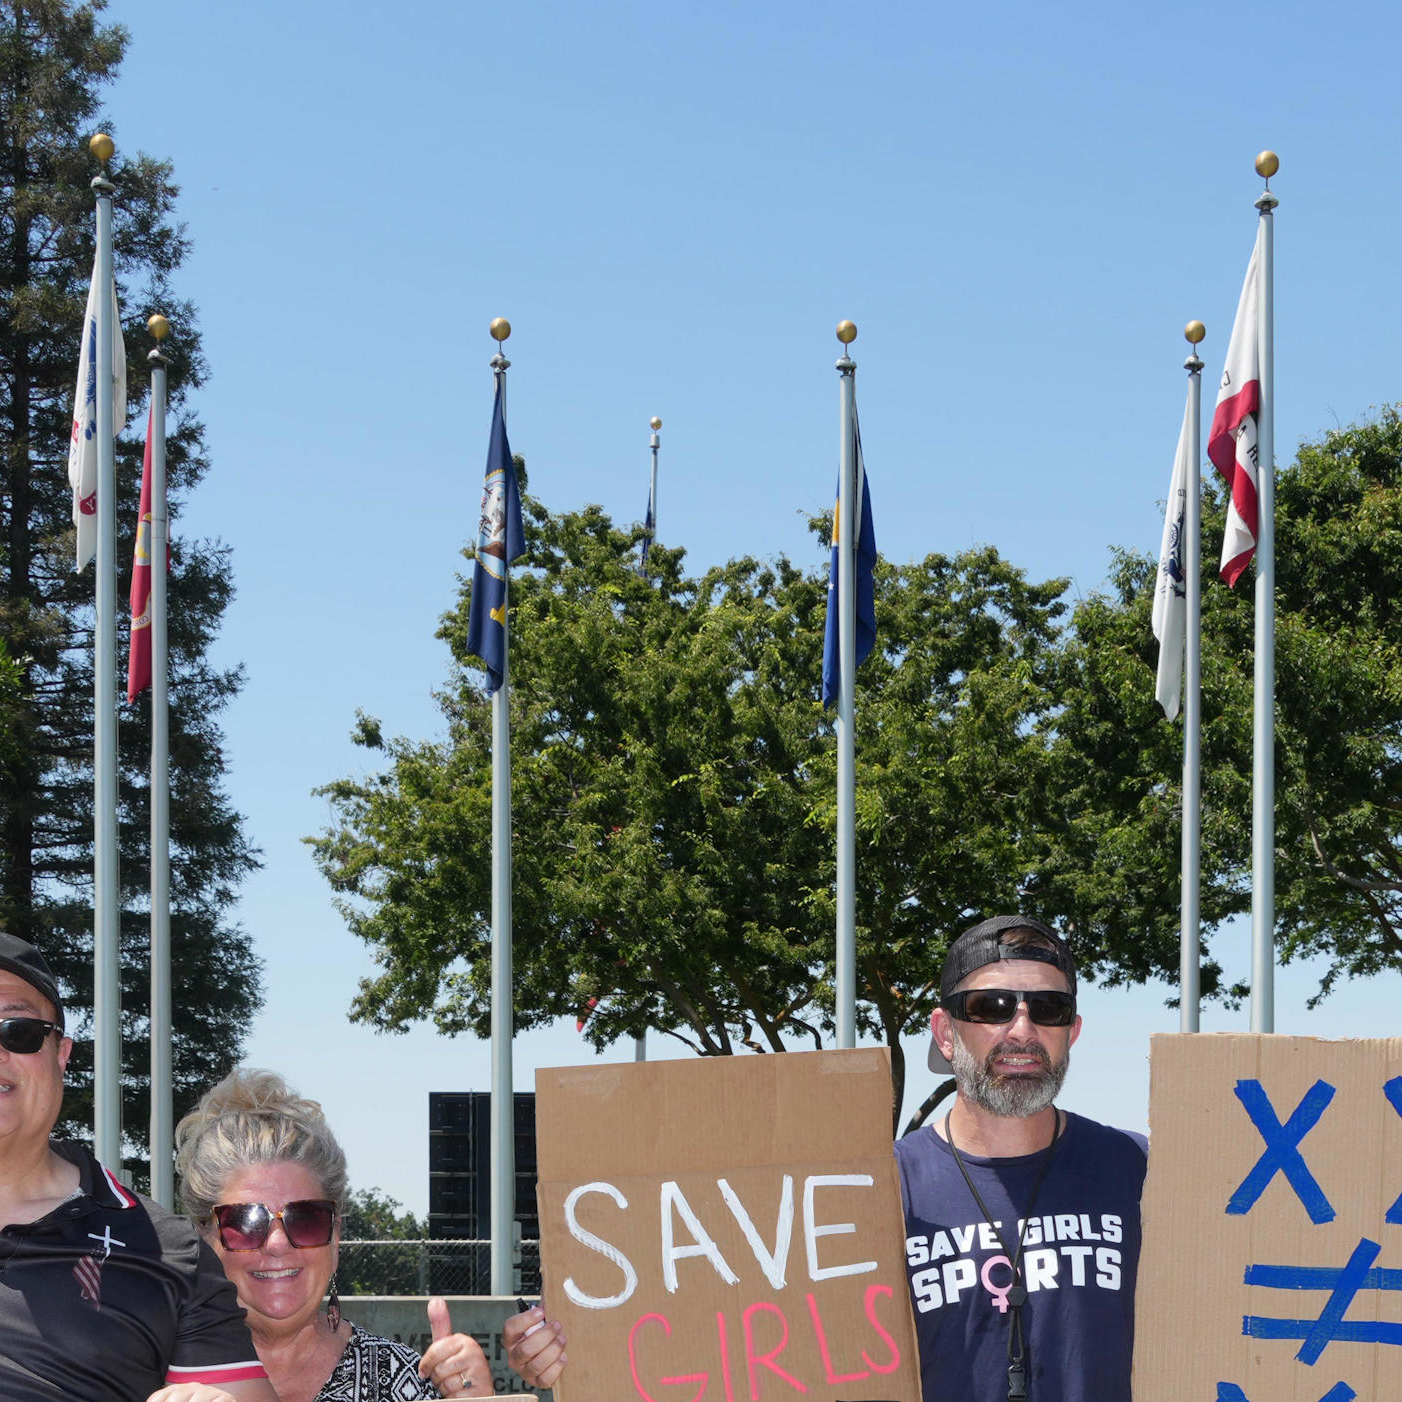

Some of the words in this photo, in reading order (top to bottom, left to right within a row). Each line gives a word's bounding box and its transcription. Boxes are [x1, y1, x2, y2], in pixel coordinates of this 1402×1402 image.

[562, 1174, 878, 1310] SAVE
[905, 1221, 1003, 1267] SAVE
[1017, 1214, 1123, 1246] GIRLS
